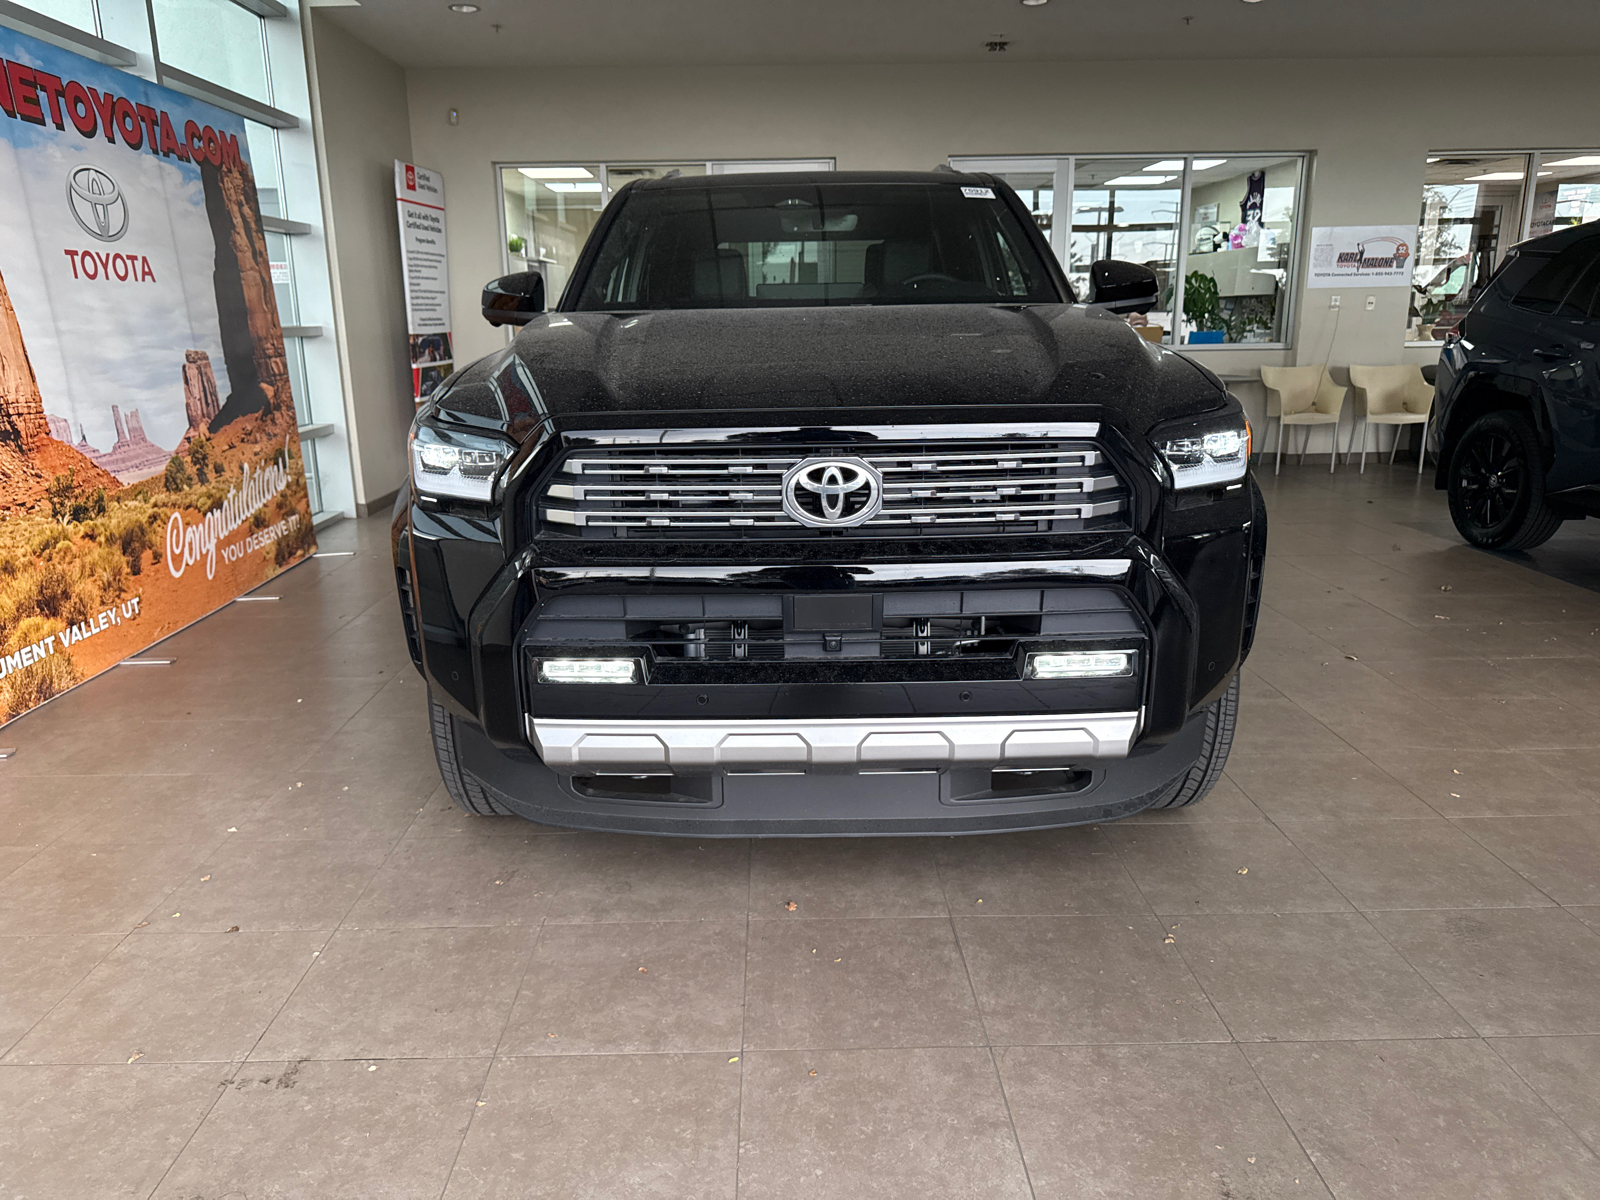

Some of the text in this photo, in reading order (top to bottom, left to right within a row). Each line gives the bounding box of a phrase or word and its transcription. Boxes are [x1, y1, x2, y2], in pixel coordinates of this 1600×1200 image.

[64, 249, 156, 283] TOYOTA
[1361, 256, 1394, 268] MALONE
[167, 433, 292, 580] Congratulations!
[221, 513, 301, 565] YOU DESERVE IT!
[58, 607, 121, 648] VALLEY,
[121, 597, 140, 619] UT
